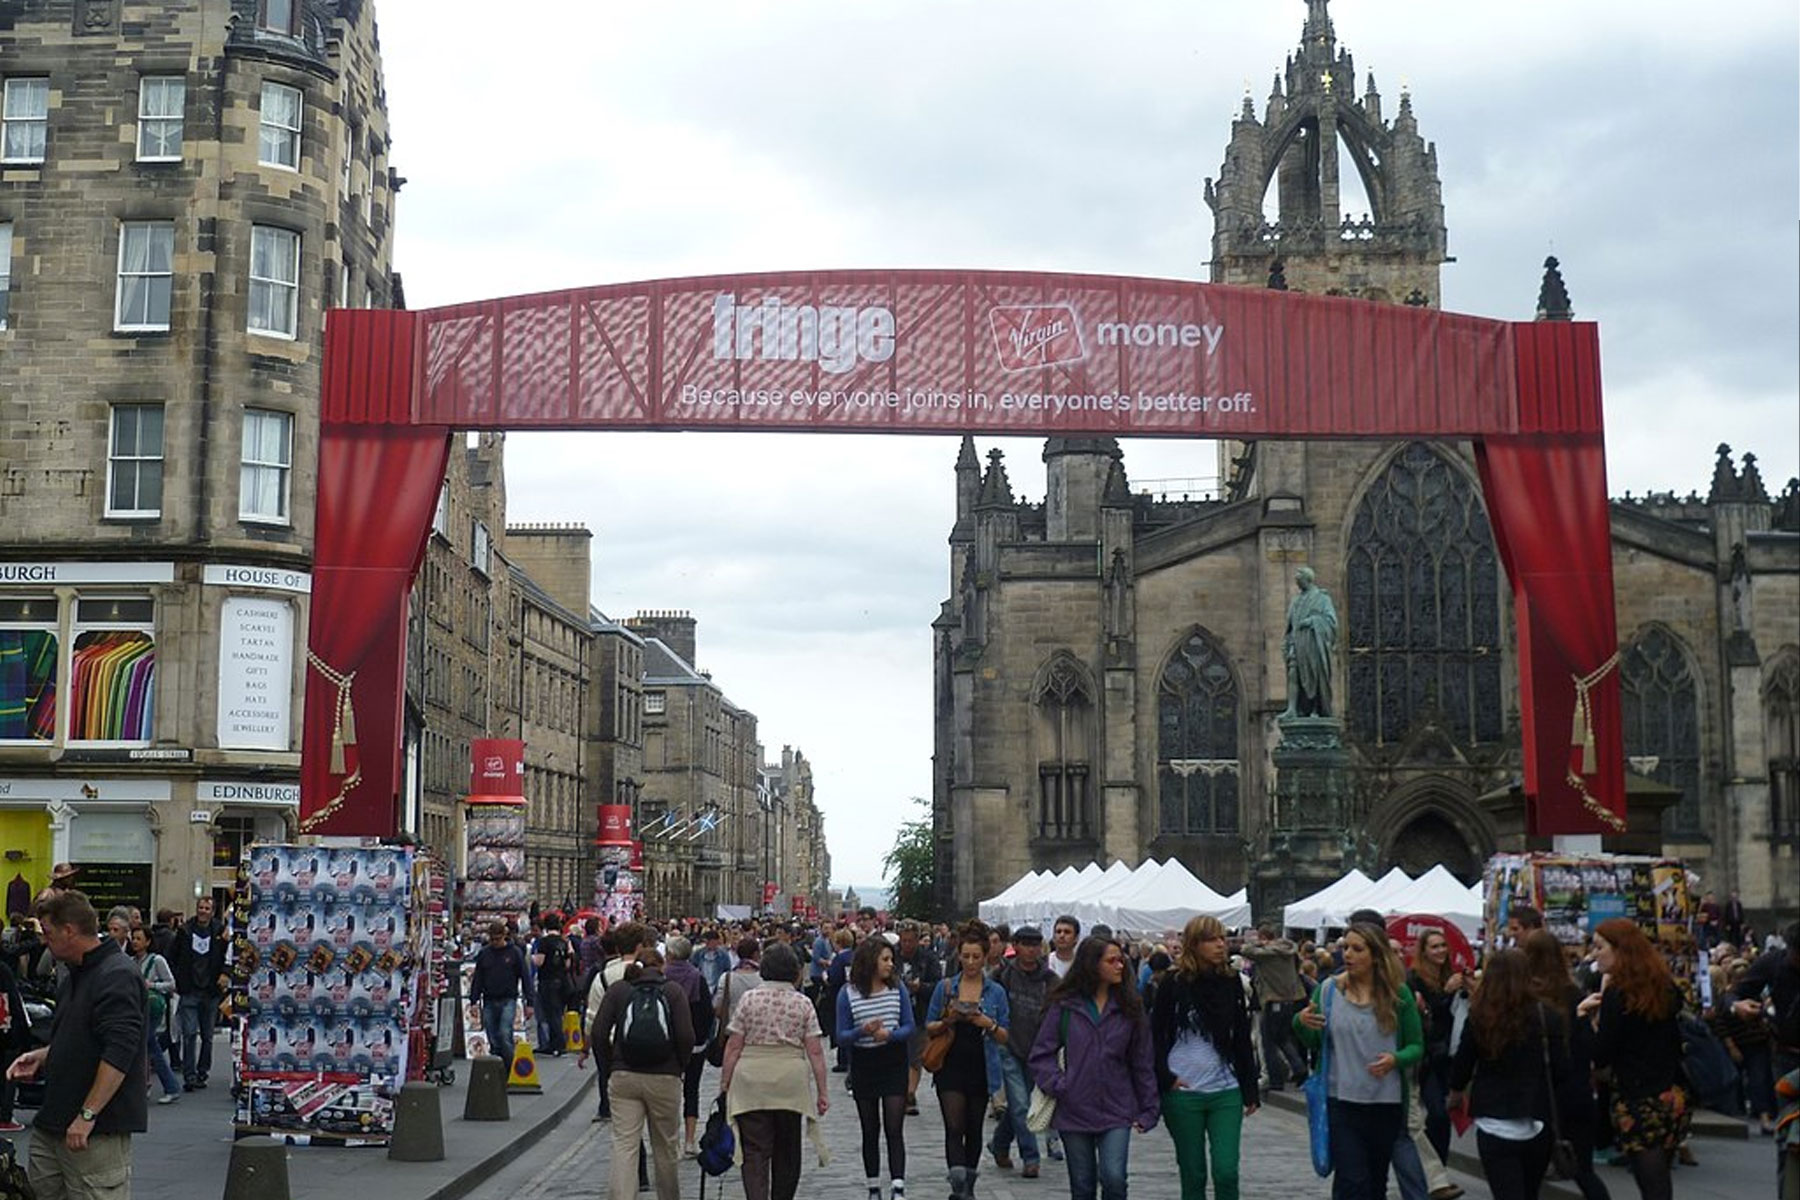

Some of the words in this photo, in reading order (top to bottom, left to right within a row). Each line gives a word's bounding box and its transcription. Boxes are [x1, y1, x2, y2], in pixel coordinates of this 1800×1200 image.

[711, 293, 896, 374] fringe
[1008, 309, 1068, 362] Virgin
[1096, 321, 1225, 356] money
[682, 384, 783, 406] Because
[790, 389, 899, 413] everyone
[902, 388, 960, 413] joins
[967, 388, 994, 412] in,
[1000, 391, 1131, 414] everyone's
[1138, 391, 1211, 412] better
[1217, 392, 1257, 413] off.
[226, 569, 280, 585] HOUSE
[284, 575, 301, 587] OF
[245, 681, 268, 690] BAGS
[213, 785, 300, 801] EDINBURGH
